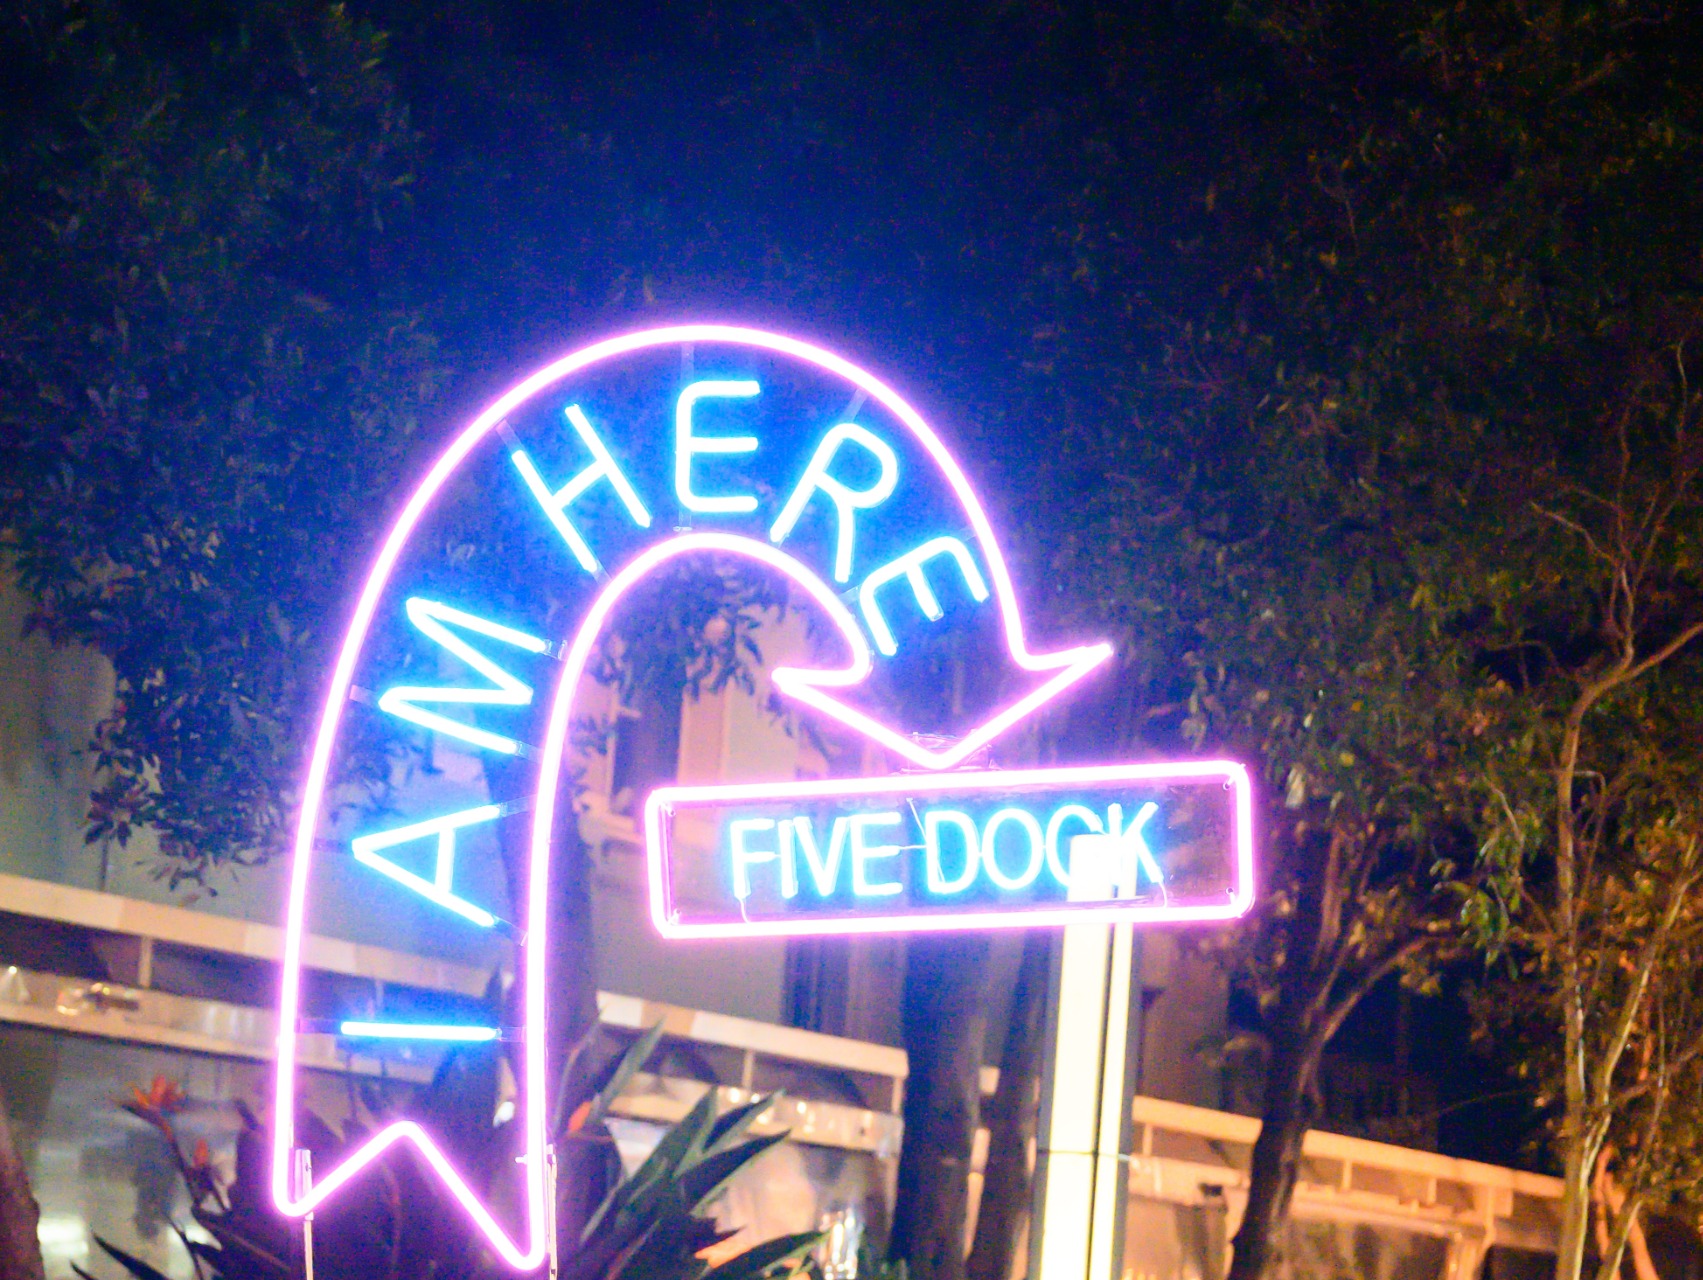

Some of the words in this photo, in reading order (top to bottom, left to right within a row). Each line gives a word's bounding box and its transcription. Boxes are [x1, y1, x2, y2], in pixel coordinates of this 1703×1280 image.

[352, 596, 548, 927] AM
[511, 379, 991, 656] HERE
[729, 811, 903, 898] FIVE
[925, 801, 1165, 893] DOCK
